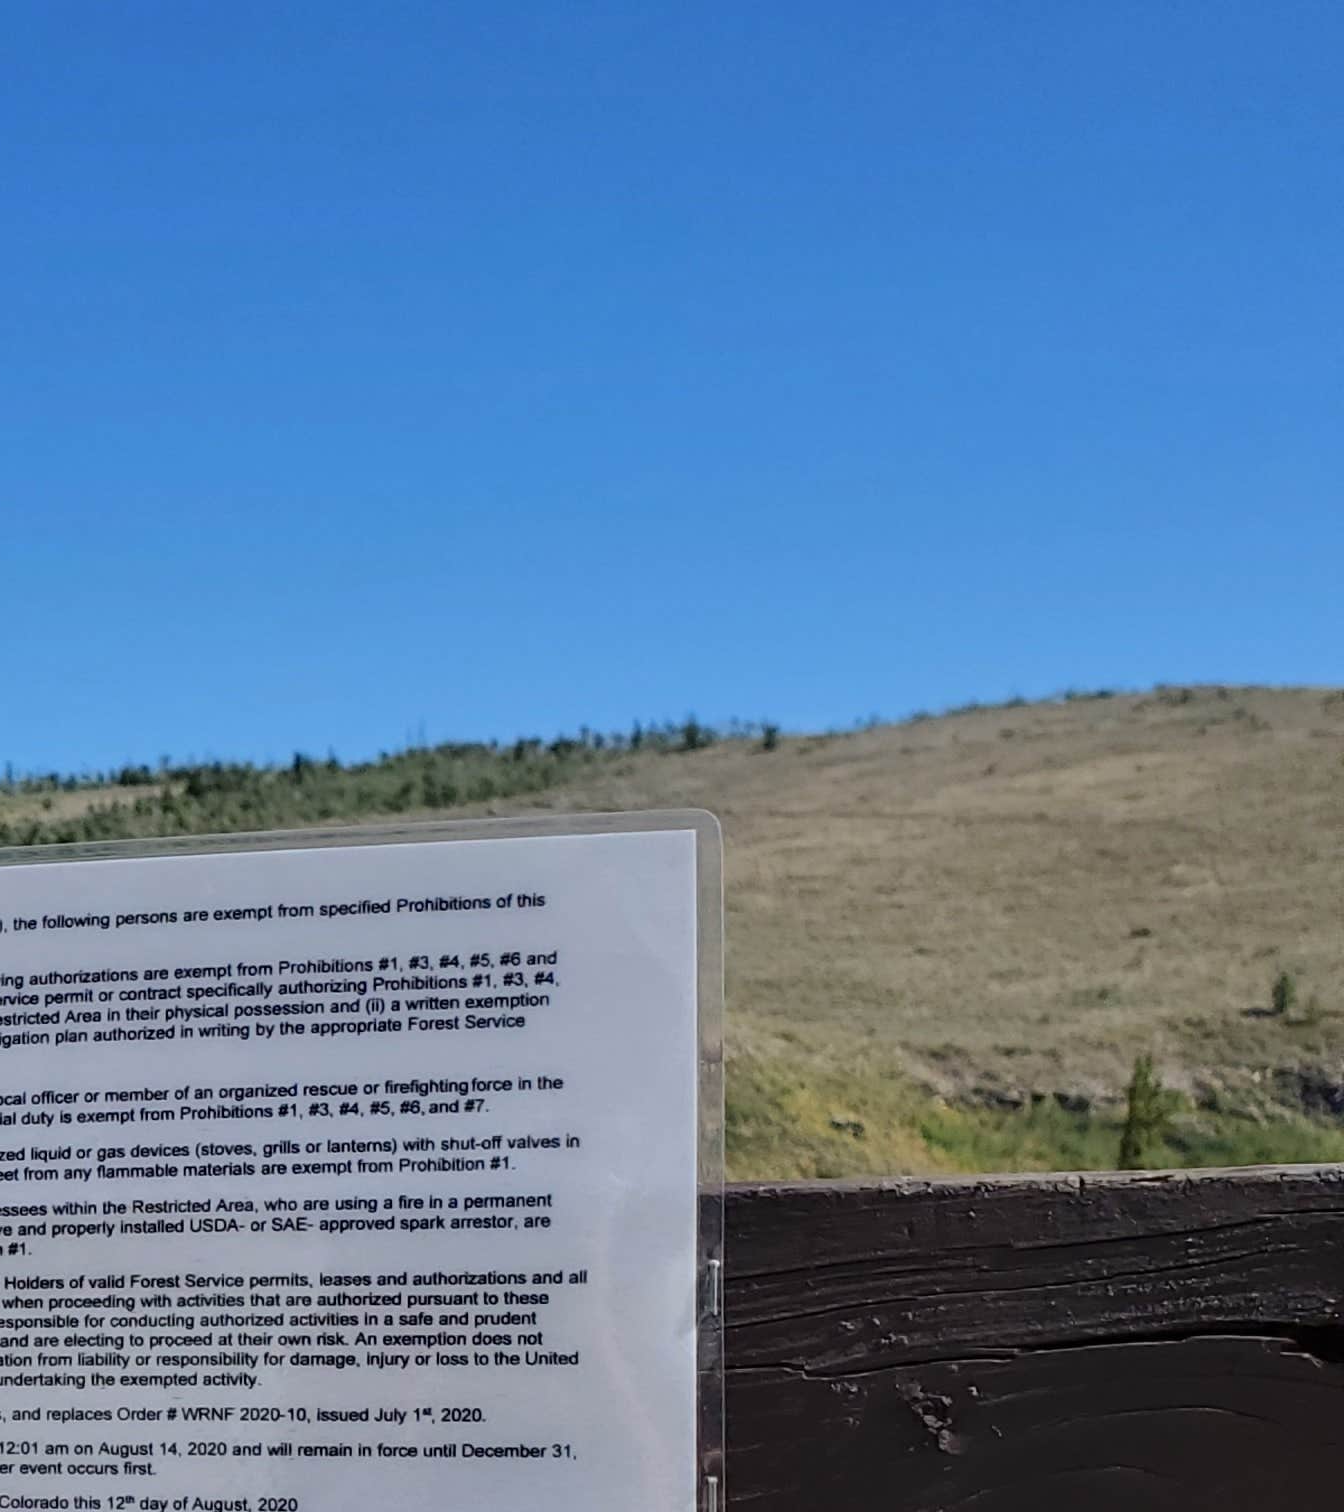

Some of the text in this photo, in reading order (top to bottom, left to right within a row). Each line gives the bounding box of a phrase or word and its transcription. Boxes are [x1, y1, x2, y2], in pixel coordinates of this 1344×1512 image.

[13, 917, 37, 931] the
[41, 912, 110, 929] following
[115, 911, 177, 928] persons
[183, 910, 208, 922] are
[212, 904, 273, 921] exempt
[277, 903, 314, 917] from
[319, 899, 390, 918] specified
[396, 896, 491, 912] Prohibitions
[495, 893, 512, 908] of
[516, 892, 545, 908] this
[7, 1241, 31, 1256] #1.
[11, 1407, 41, 1421] and
[46, 1407, 112, 1424] replaces
[116, 1406, 163, 1421] Order
[166, 1407, 177, 1421] #
[181, 1406, 235, 1421] WRNF
[239, 1407, 310, 1424] 2020-10,
[316, 1407, 369, 1422] issued
[373, 1407, 407, 1425] July
[440, 1407, 486, 1422] 2020.
[73, 1495, 101, 1510] this
[139, 1496, 168, 1512] day
[172, 1495, 188, 1511] of
[257, 1497, 298, 1512] 2020
